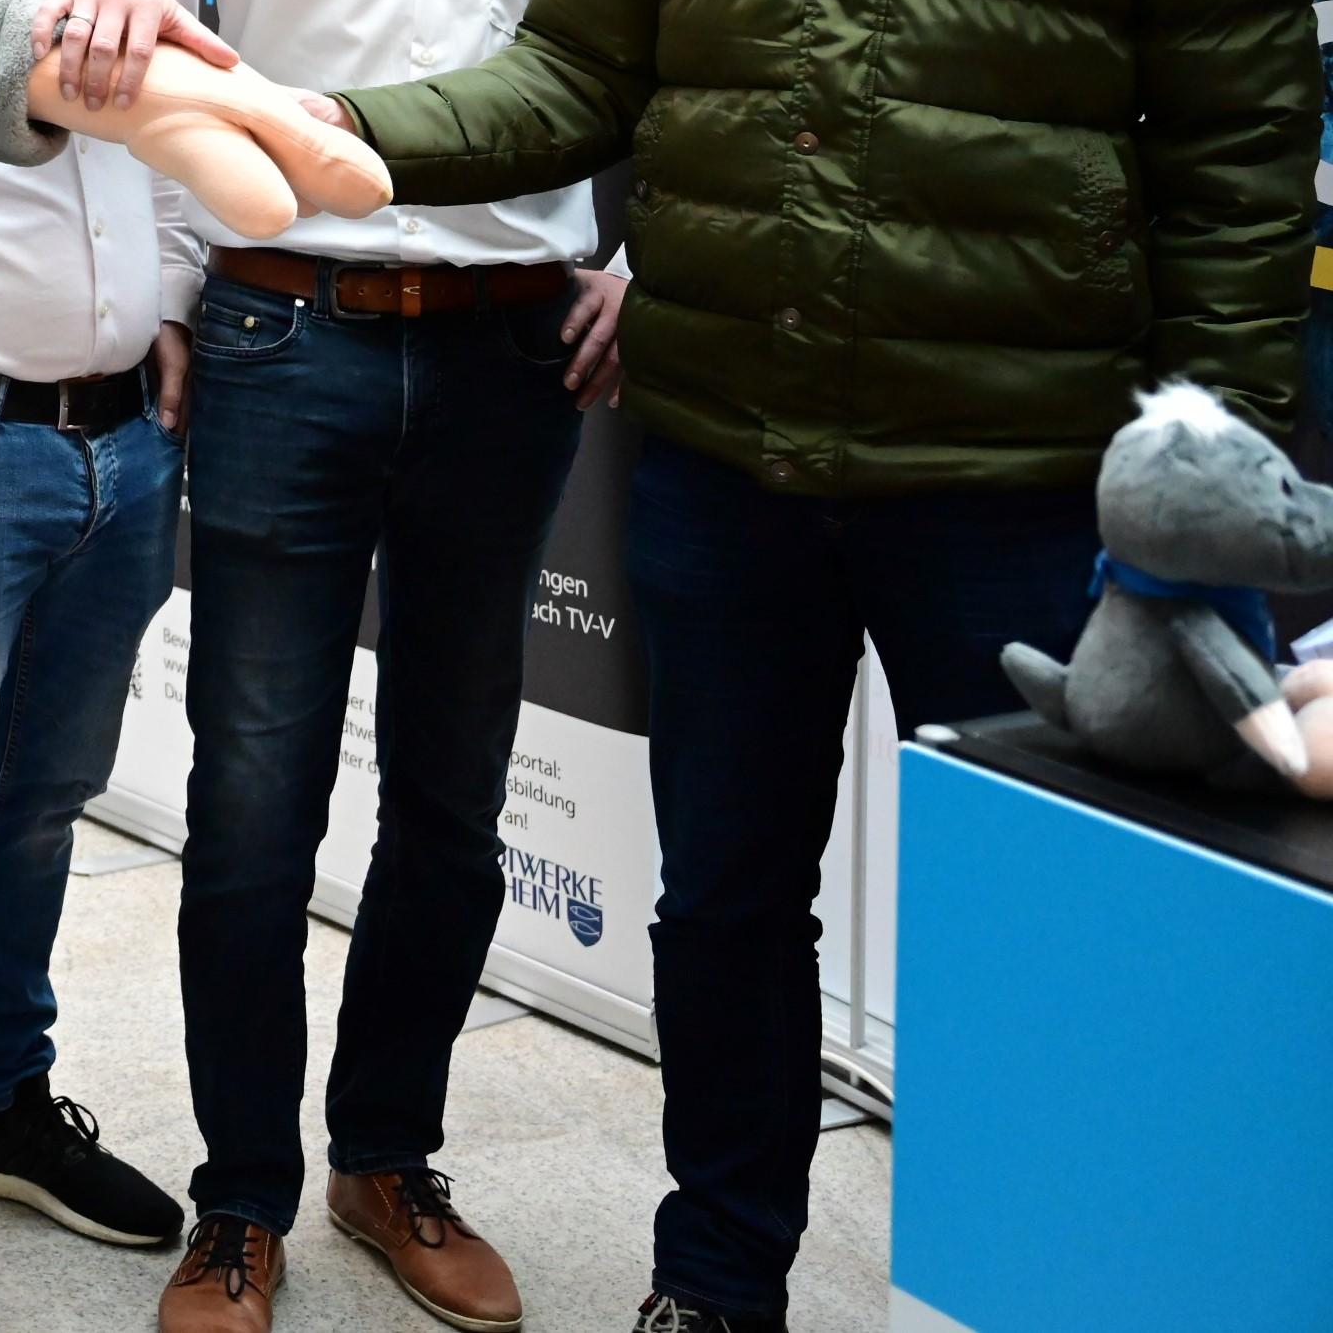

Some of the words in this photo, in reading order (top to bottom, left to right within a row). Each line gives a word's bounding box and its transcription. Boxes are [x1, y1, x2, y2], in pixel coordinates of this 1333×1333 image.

[539, 569, 588, 598] ngen
[565, 606, 615, 640] TV-V
[165, 681, 183, 703] Du
[510, 751, 562, 781] portal:
[507, 777, 576, 819] sbildung
[504, 810, 529, 831] an!
